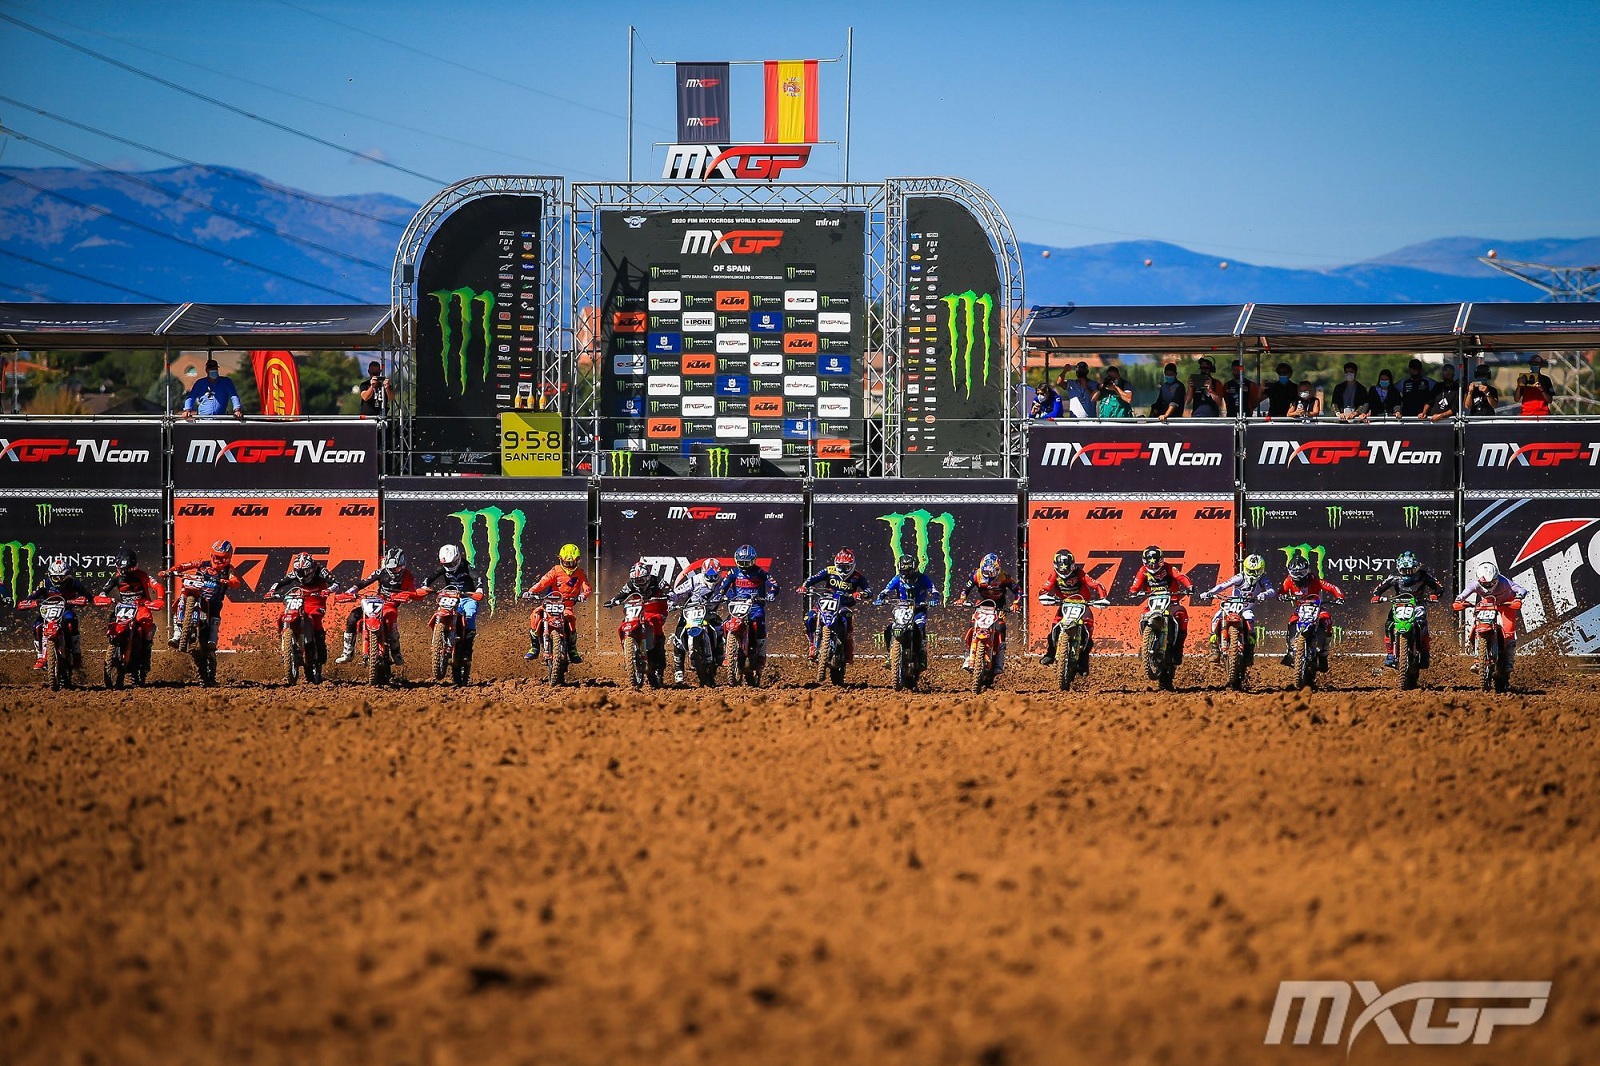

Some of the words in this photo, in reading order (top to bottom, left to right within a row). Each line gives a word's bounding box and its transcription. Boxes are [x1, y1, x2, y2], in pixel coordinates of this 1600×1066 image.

[686, 79, 720, 87] MXGP
[686, 117, 720, 126] MXGP
[662, 145, 812, 181] MXGP
[680, 229, 784, 258] MXGP
[721, 297, 745, 305] KTM
[788, 339, 813, 347] KTM
[686, 360, 711, 368] KTM
[754, 402, 779, 411] KTM
[652, 424, 676, 432] KTM
[821, 445, 846, 453] KTM
[505, 453, 561, 461] SANTERO
[1477, 442, 1600, 471] MXGP-T
[178, 503, 215, 516] KTM
[231, 503, 268, 516] KTM
[285, 503, 322, 516] KTM
[338, 503, 375, 516] KTM
[1032, 507, 1069, 519] KTM
[1086, 507, 1123, 519] KTM
[1140, 507, 1177, 519] KTM
[1194, 507, 1231, 519] KTM
[38, 553, 118, 568] MONSTE
[1327, 555, 1396, 572] MONST
[545, 603, 564, 613] 253
[820, 600, 837, 610] 70
[1152, 599, 1165, 609] 14
[117, 608, 134, 617] 44
[1066, 606, 1081, 617] 19
[1477, 610, 1495, 619] 426
[977, 613, 995, 625] 28
